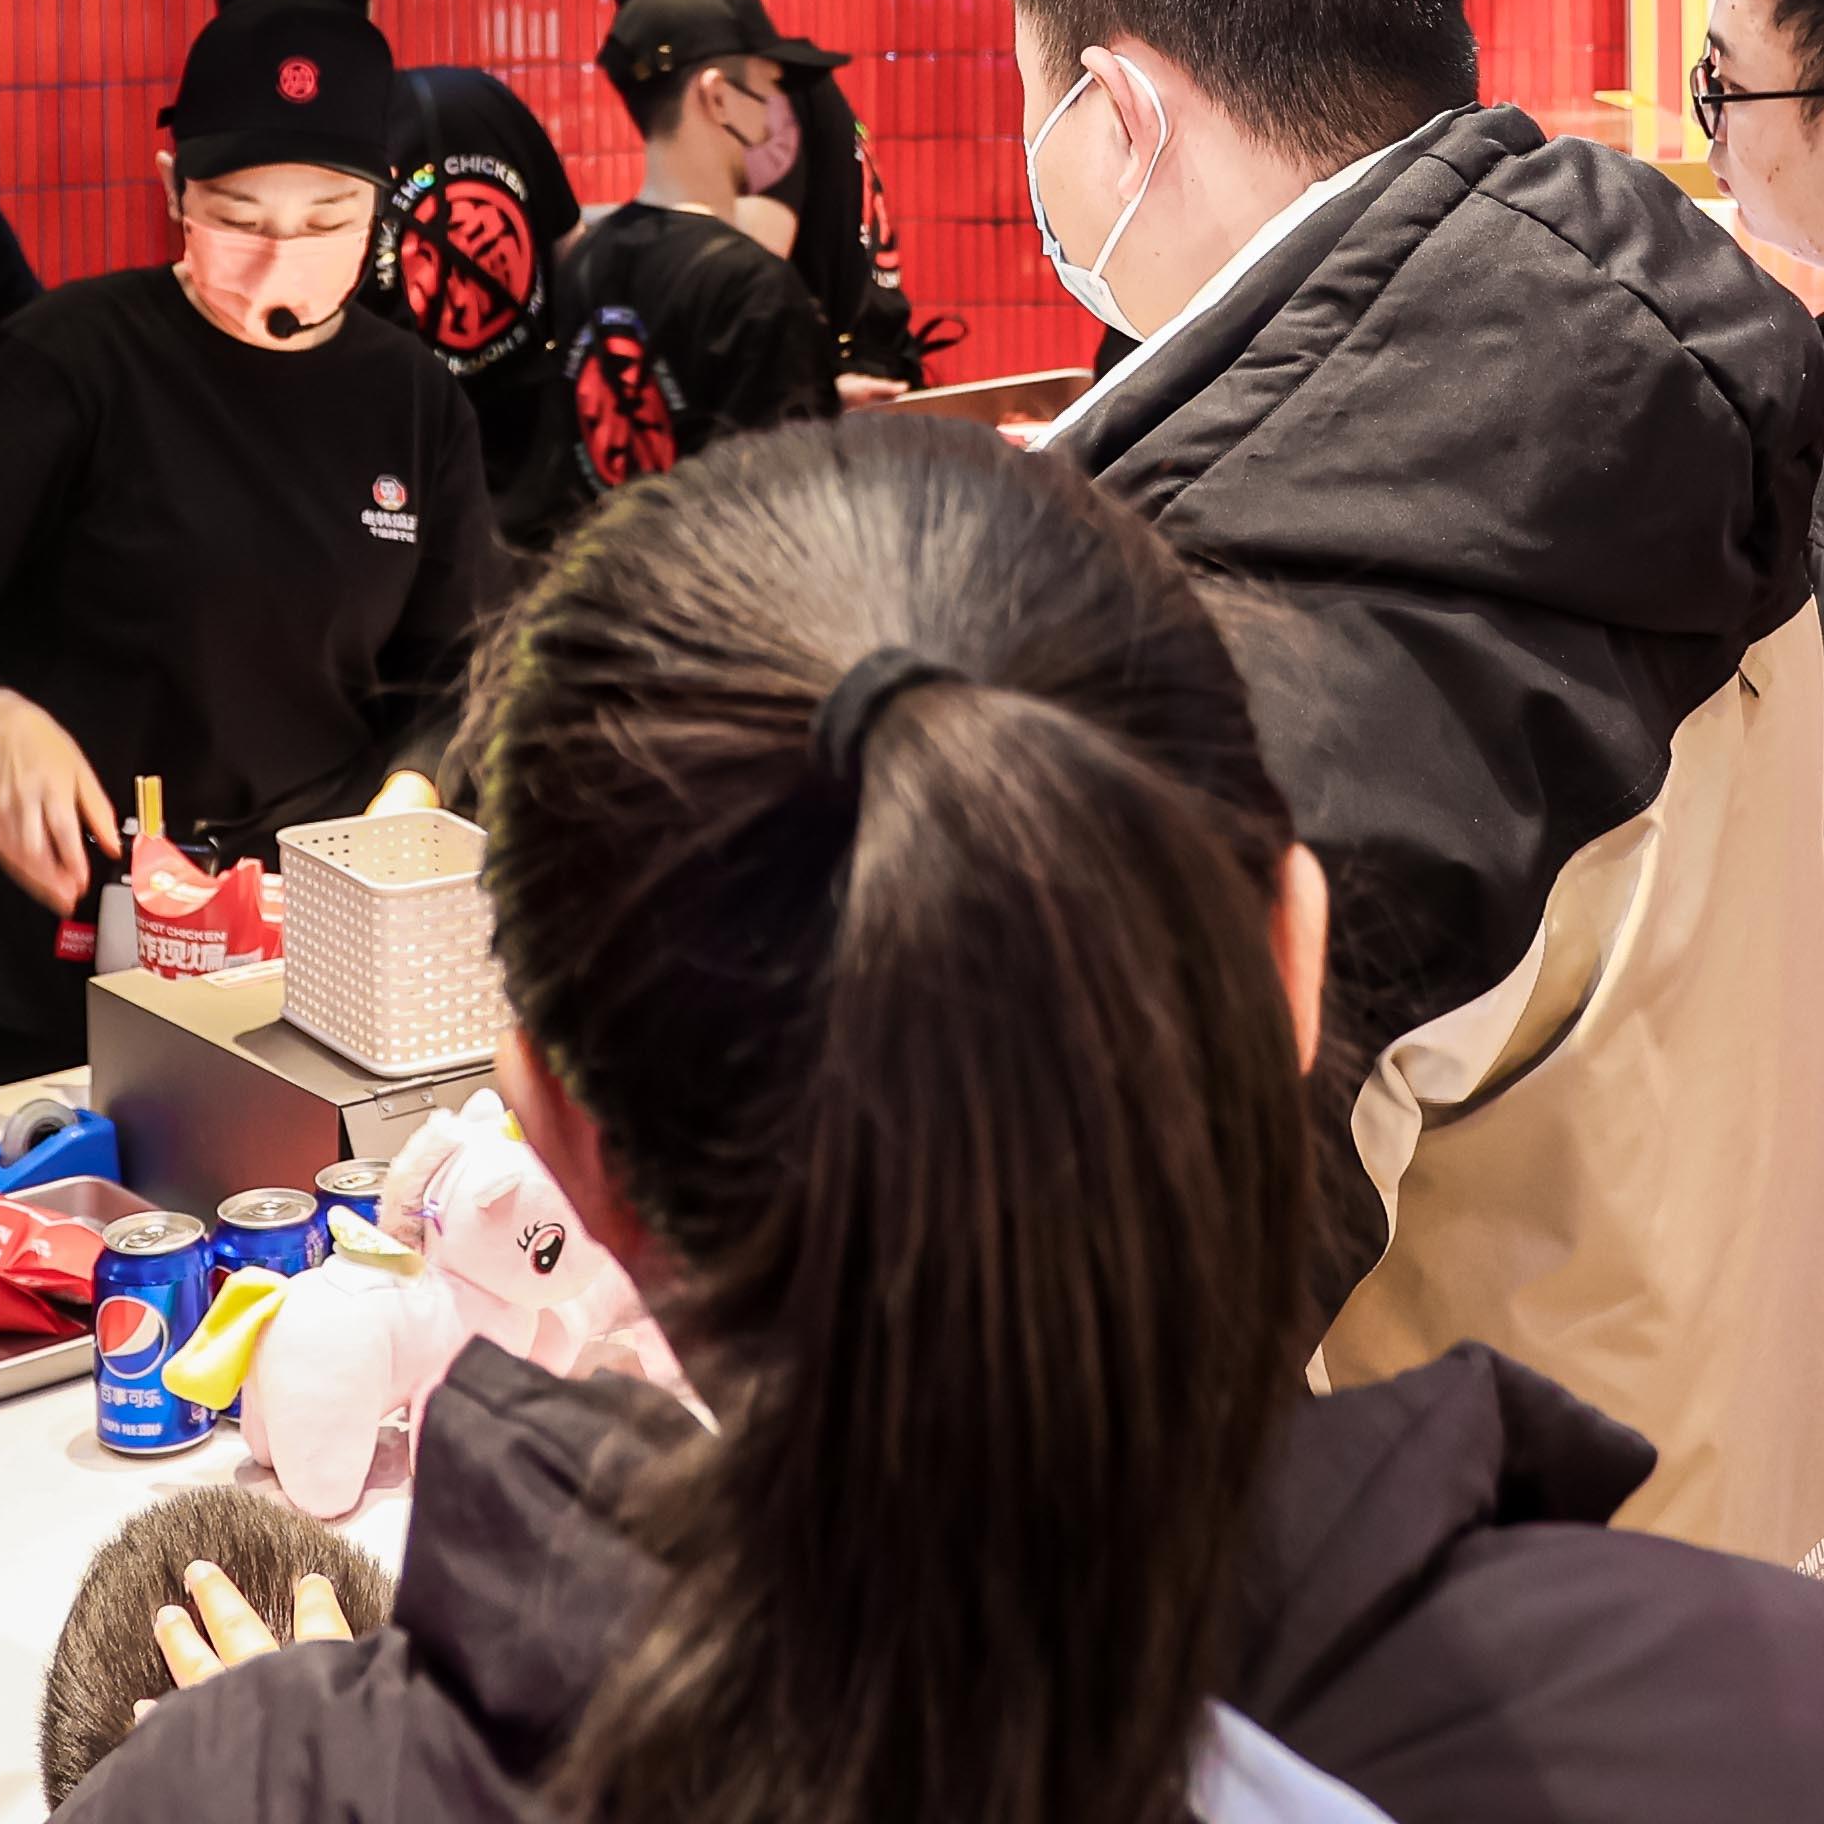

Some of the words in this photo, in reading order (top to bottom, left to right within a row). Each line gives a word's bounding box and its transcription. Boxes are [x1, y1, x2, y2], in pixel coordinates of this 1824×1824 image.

[165, 925, 229, 943] CHICKEN
[99, 1383, 164, 1409] 百事可乐
